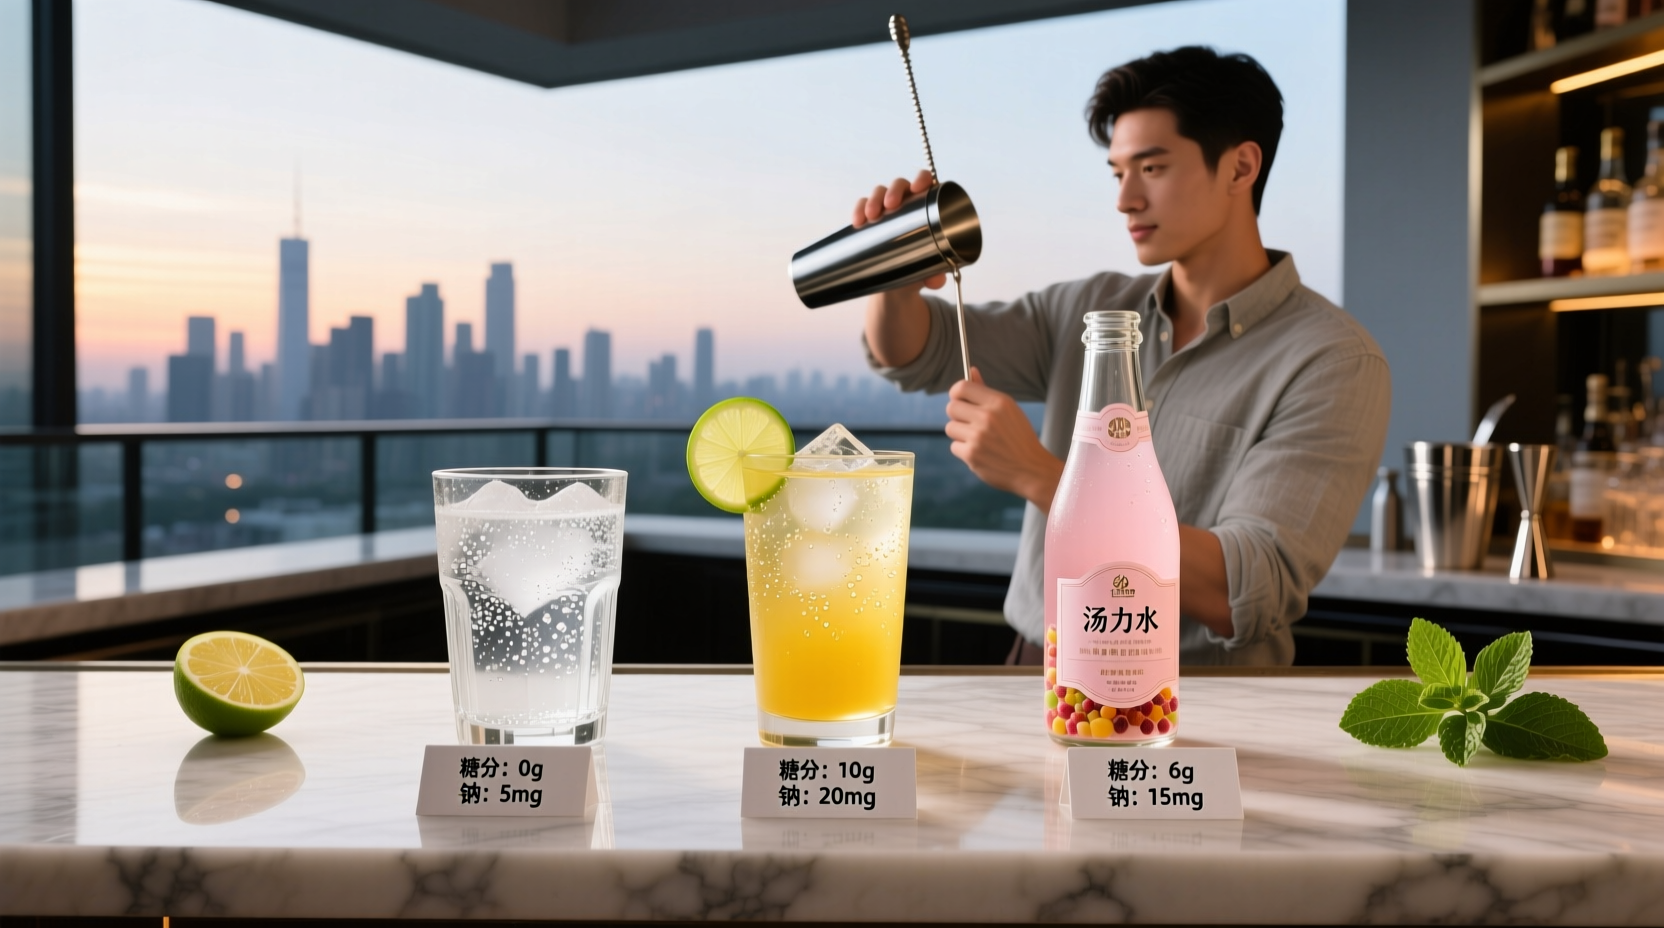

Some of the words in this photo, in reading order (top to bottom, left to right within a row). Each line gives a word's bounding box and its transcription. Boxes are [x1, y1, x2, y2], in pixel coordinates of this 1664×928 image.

[1083, 606, 1158, 633] 汤力水
[460, 757, 543, 781] 糖分：0g
[779, 759, 875, 784] 糖分：10g
[1108, 759, 1194, 784] 糖分：6g
